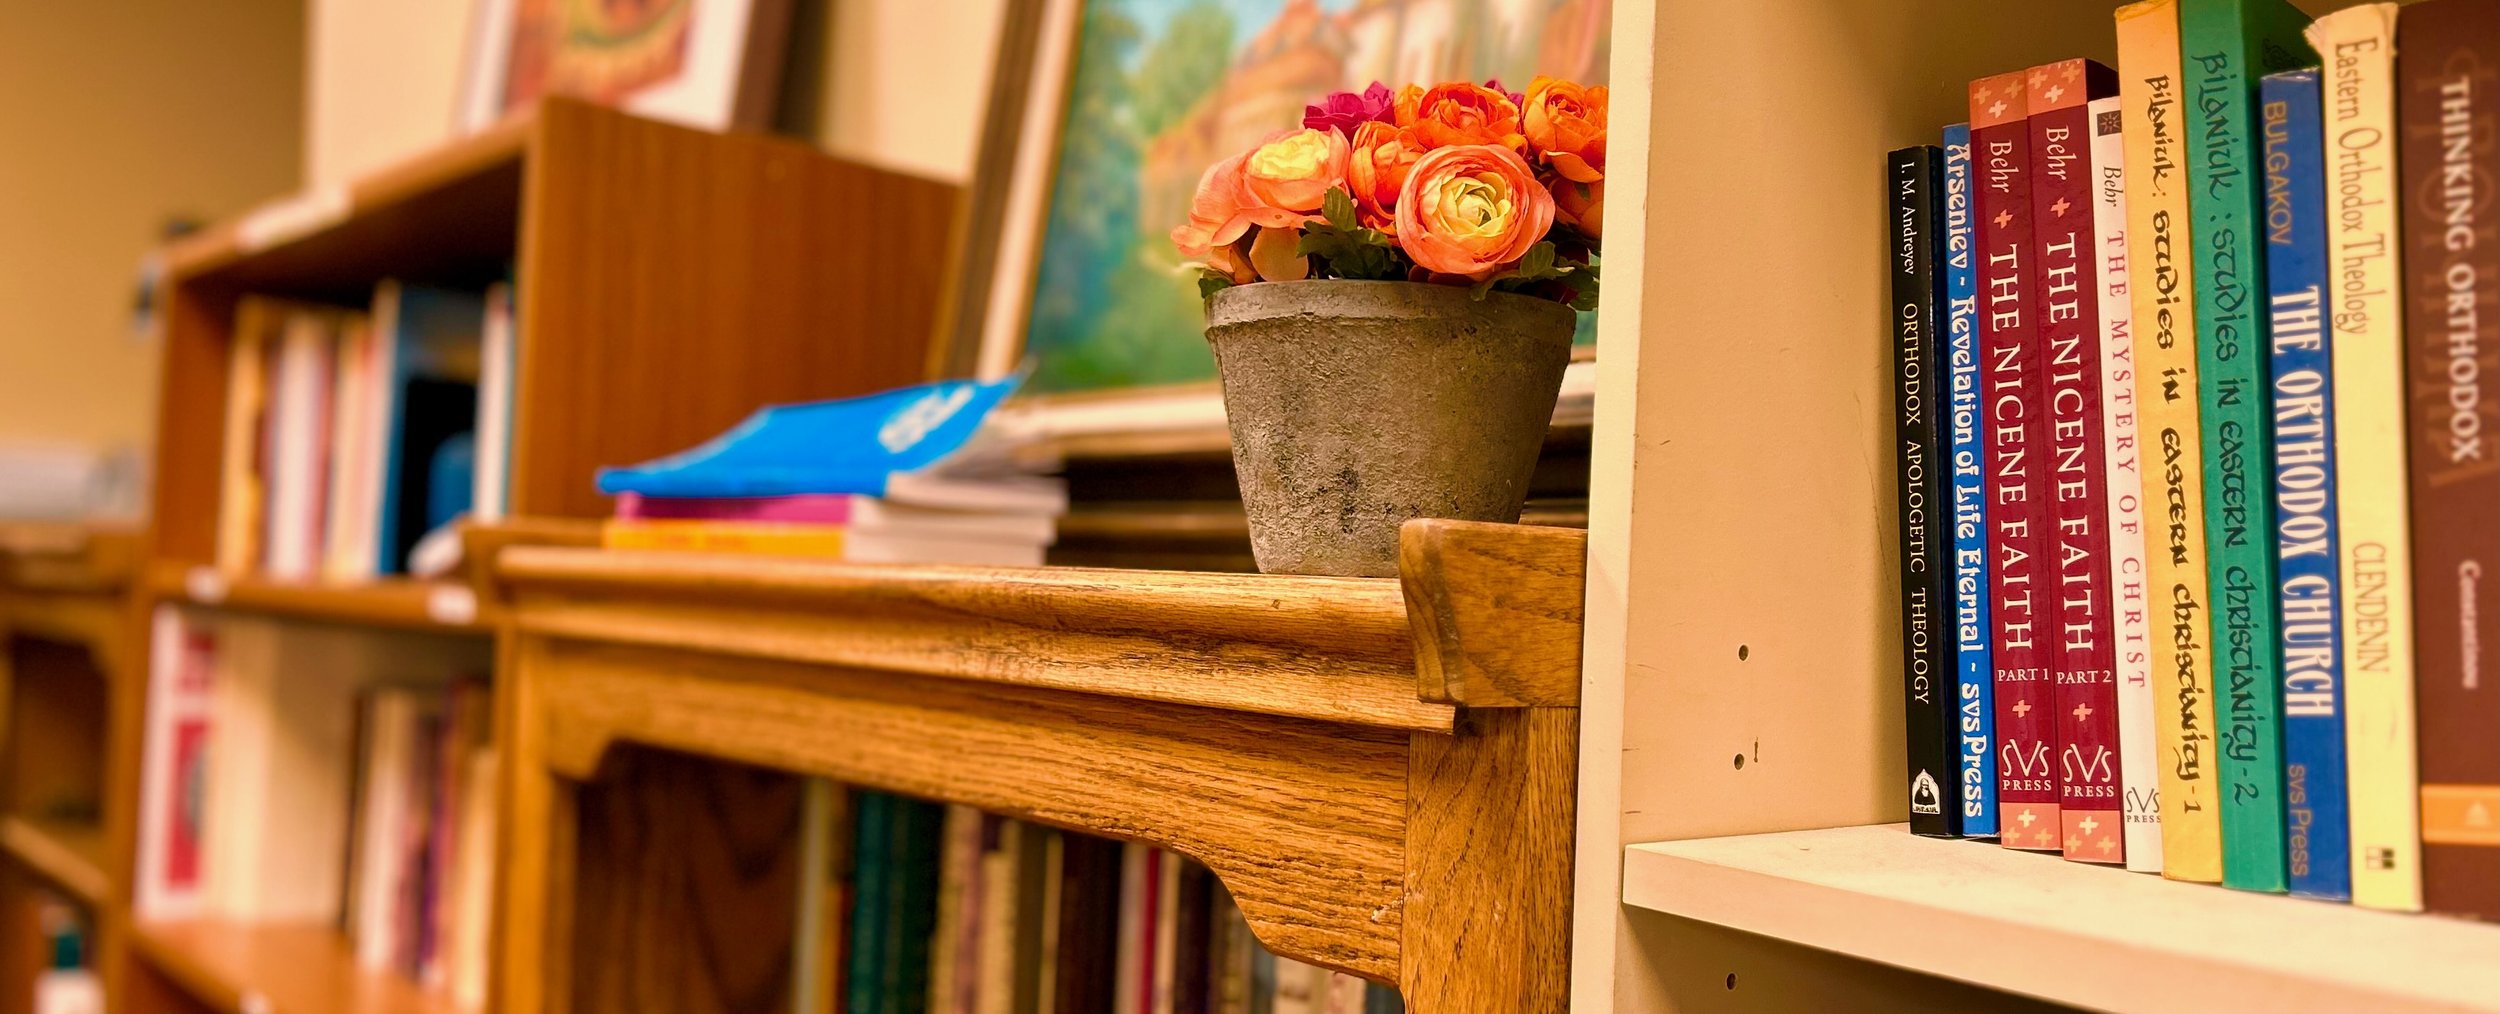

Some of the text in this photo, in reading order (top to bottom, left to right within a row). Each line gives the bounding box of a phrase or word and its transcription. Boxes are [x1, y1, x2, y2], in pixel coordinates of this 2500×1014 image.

[1989, 139, 2019, 193] Behr
[2046, 125, 2077, 181] Behr
[2263, 101, 2293, 245] BULGAKOV
[1902, 178, 1916, 200] M.
[1947, 143, 1971, 269] Arseniev
[2103, 165, 2124, 207] Behr
[2334, 37, 2387, 334] Eastern Orthodox Theology
[1902, 206, 1918, 275] Andreyev
[2441, 77, 2481, 462] THINKING ORTHODOX
[1951, 294, 1980, 445] Revelation
[1955, 451, 1979, 476] of
[1989, 244, 2033, 651] THE NICENE FAITH
[2046, 232, 2094, 654] THE NICENE FAITH
[2107, 230, 2147, 688] THE MYSTERY OF CHRIST
[1903, 303, 1929, 704] ORTHODOX APOLOGETIC THEOLOGY
[1955, 485, 1981, 539] Life
[2272, 286, 2334, 716] THE ORTHODOX CHURCH
[1956, 548, 1984, 652] Eternal
[2352, 542, 2390, 674] CLENDENIN
[1998, 669, 2049, 682] PART 1
[2057, 670, 2112, 684] PART 2
[2002, 739, 2050, 777] SVS
[2003, 780, 2052, 791] PRESS
[2063, 744, 2113, 783] SVS
[2064, 785, 2114, 797] PRESS
[2125, 787, 2160, 813] SVS
[2126, 814, 2161, 823] PRESS
[2290, 809, 2313, 876] Press
